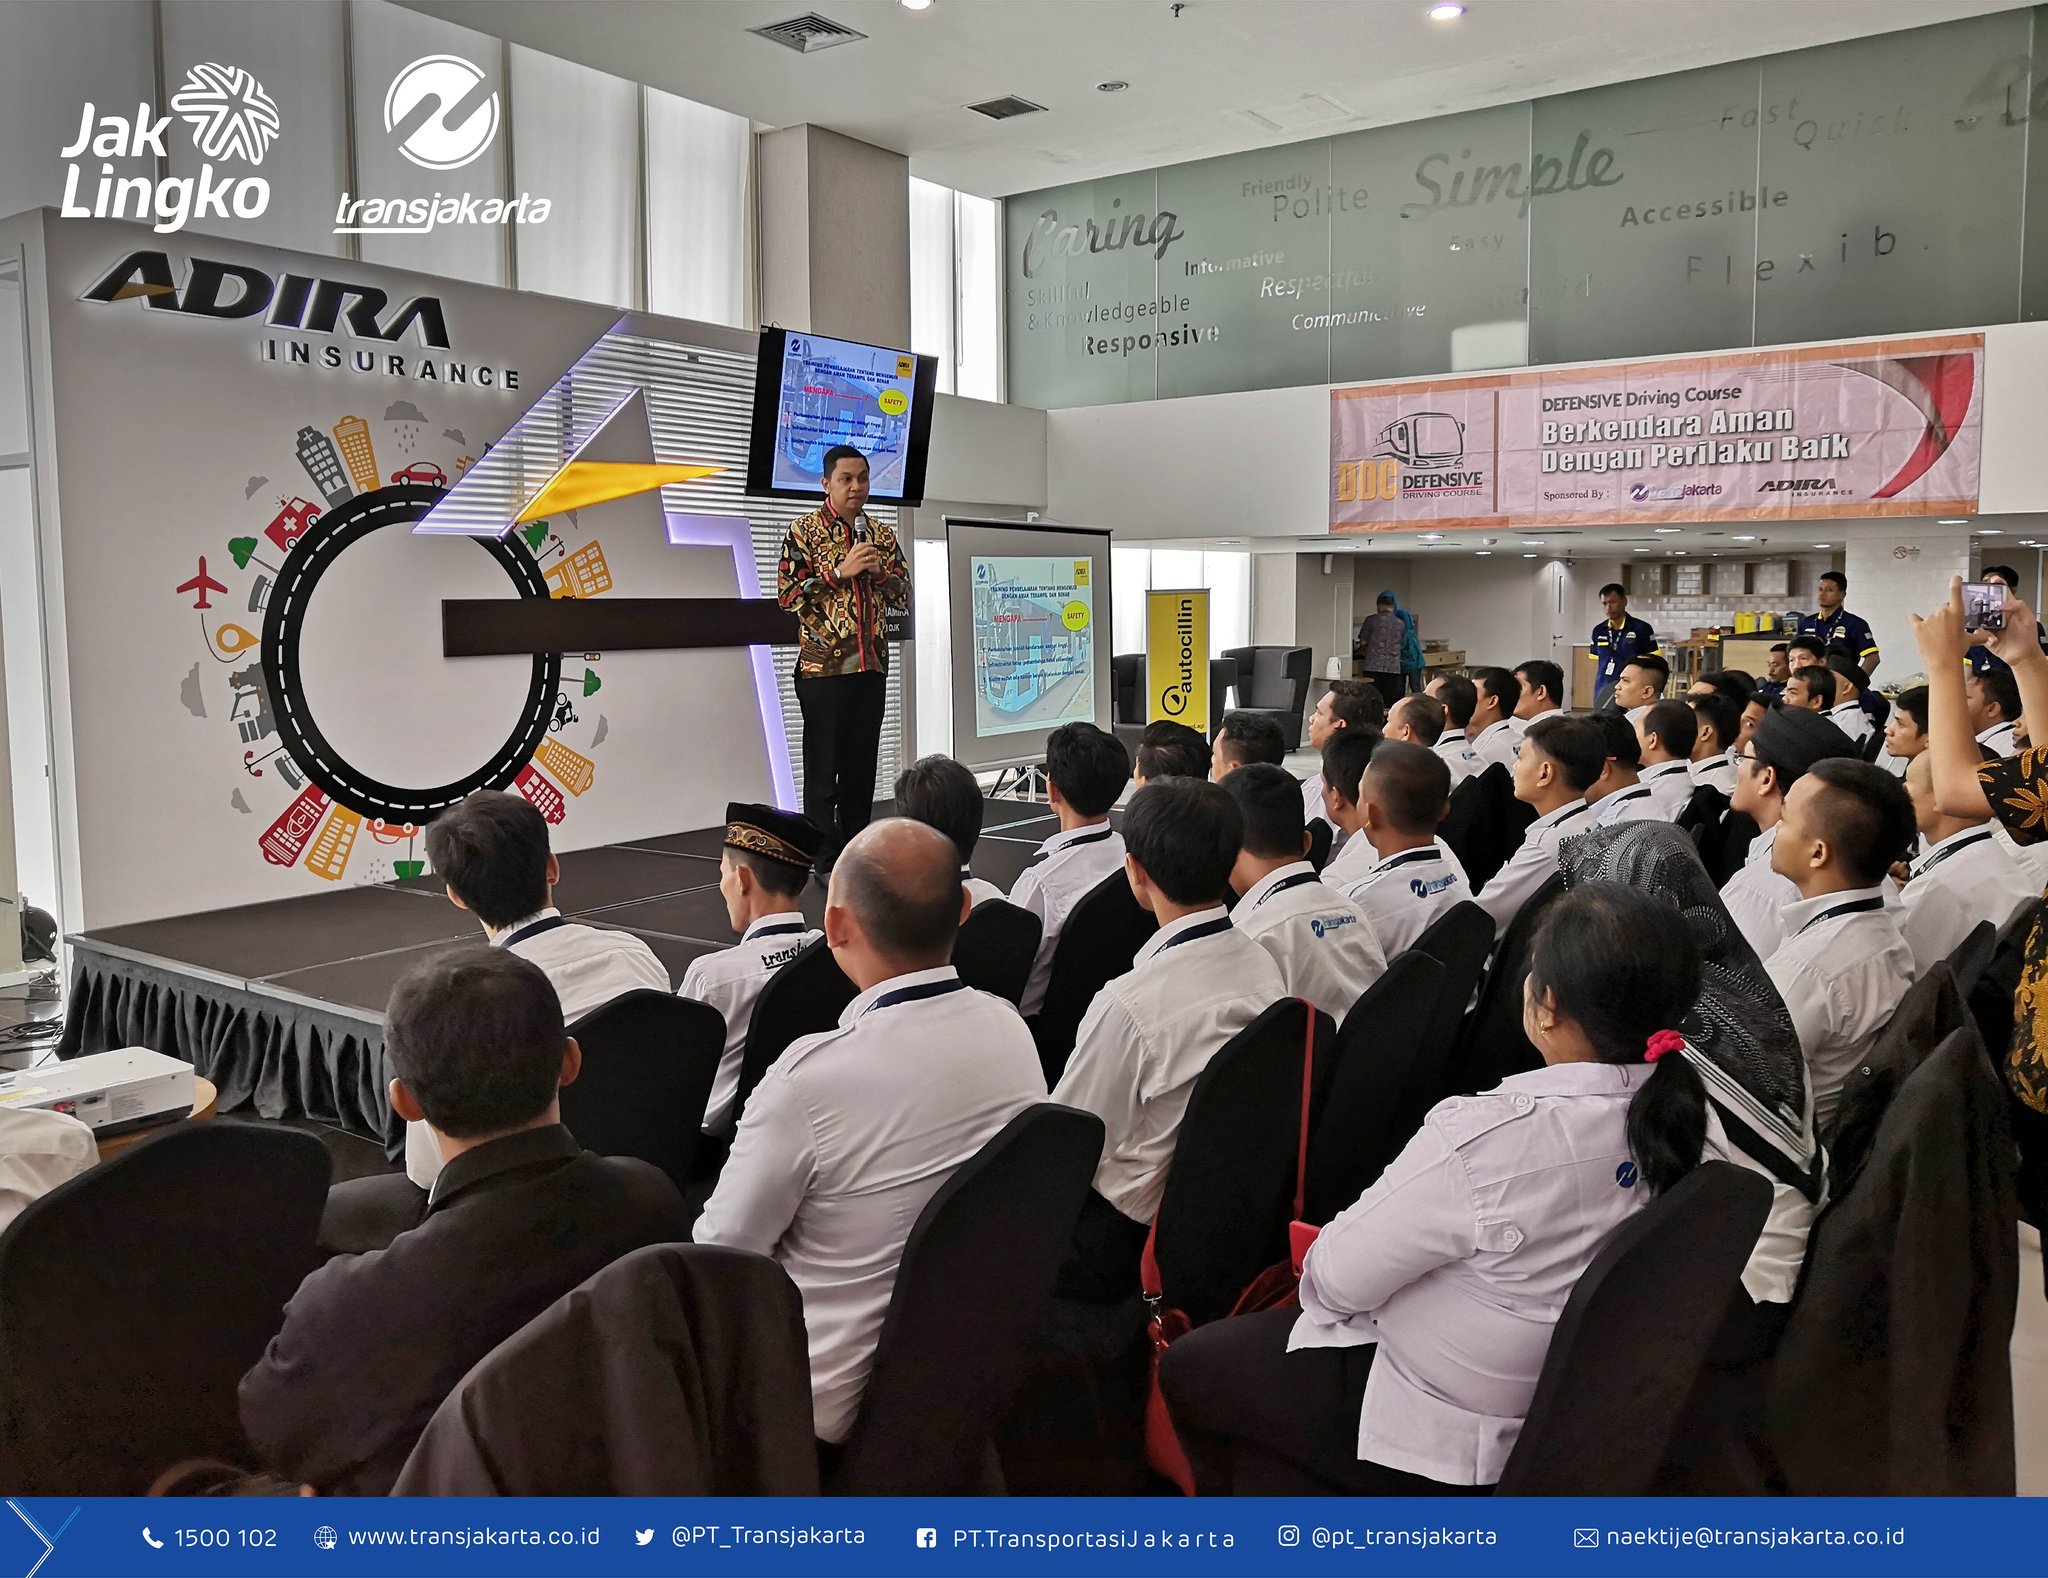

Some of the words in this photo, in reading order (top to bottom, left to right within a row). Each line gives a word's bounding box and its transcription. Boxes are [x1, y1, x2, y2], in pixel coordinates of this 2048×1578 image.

[1719, 97, 1799, 131] Fast
[1241, 175, 1312, 197] Friendly
[1400, 128, 1624, 221] Simple
[1273, 187, 1368, 222] Polite
[1620, 186, 1789, 228] Accessible
[1023, 198, 1184, 279] Caring
[1450, 233, 1504, 251] Easy
[1028, 281, 1089, 306] Skillful
[1260, 268, 1374, 300] Respectful
[80, 250, 451, 350] ADIRA
[1028, 314, 1039, 330] &
[1044, 294, 1190, 327] Knowledgeable
[1292, 305, 1426, 330] Communictive
[1082, 323, 1220, 357] Responsive
[261, 339, 519, 390] INSURANCE
[884, 397, 903, 407] SAFETY
[1542, 393, 1623, 412] DEFENSIVE
[1626, 389, 1680, 409] Driving
[1684, 386, 1743, 404] Course
[1542, 414, 1702, 446] Berkendara
[1709, 408, 1794, 435] Aman
[1541, 448, 1643, 474] Dengan
[1650, 438, 1773, 468] Perilaku
[1780, 432, 1850, 462] Baik
[1337, 458, 1399, 502] DDC
[1402, 471, 1483, 490] DEFENSIVE
[1402, 490, 1441, 499] DRIVING
[1442, 488, 1482, 498] COURSE
[1543, 489, 1589, 501] Sponsored
[1591, 489, 1604, 500] By
[1649, 483, 1723, 500] transjakarta
[1757, 478, 1837, 493] ADIRA
[1791, 489, 1854, 498] INSURANCE
[1067, 612, 1085, 620] SAFETY
[1177, 599, 1193, 694] autocillin
[761, 938, 807, 967] transj
